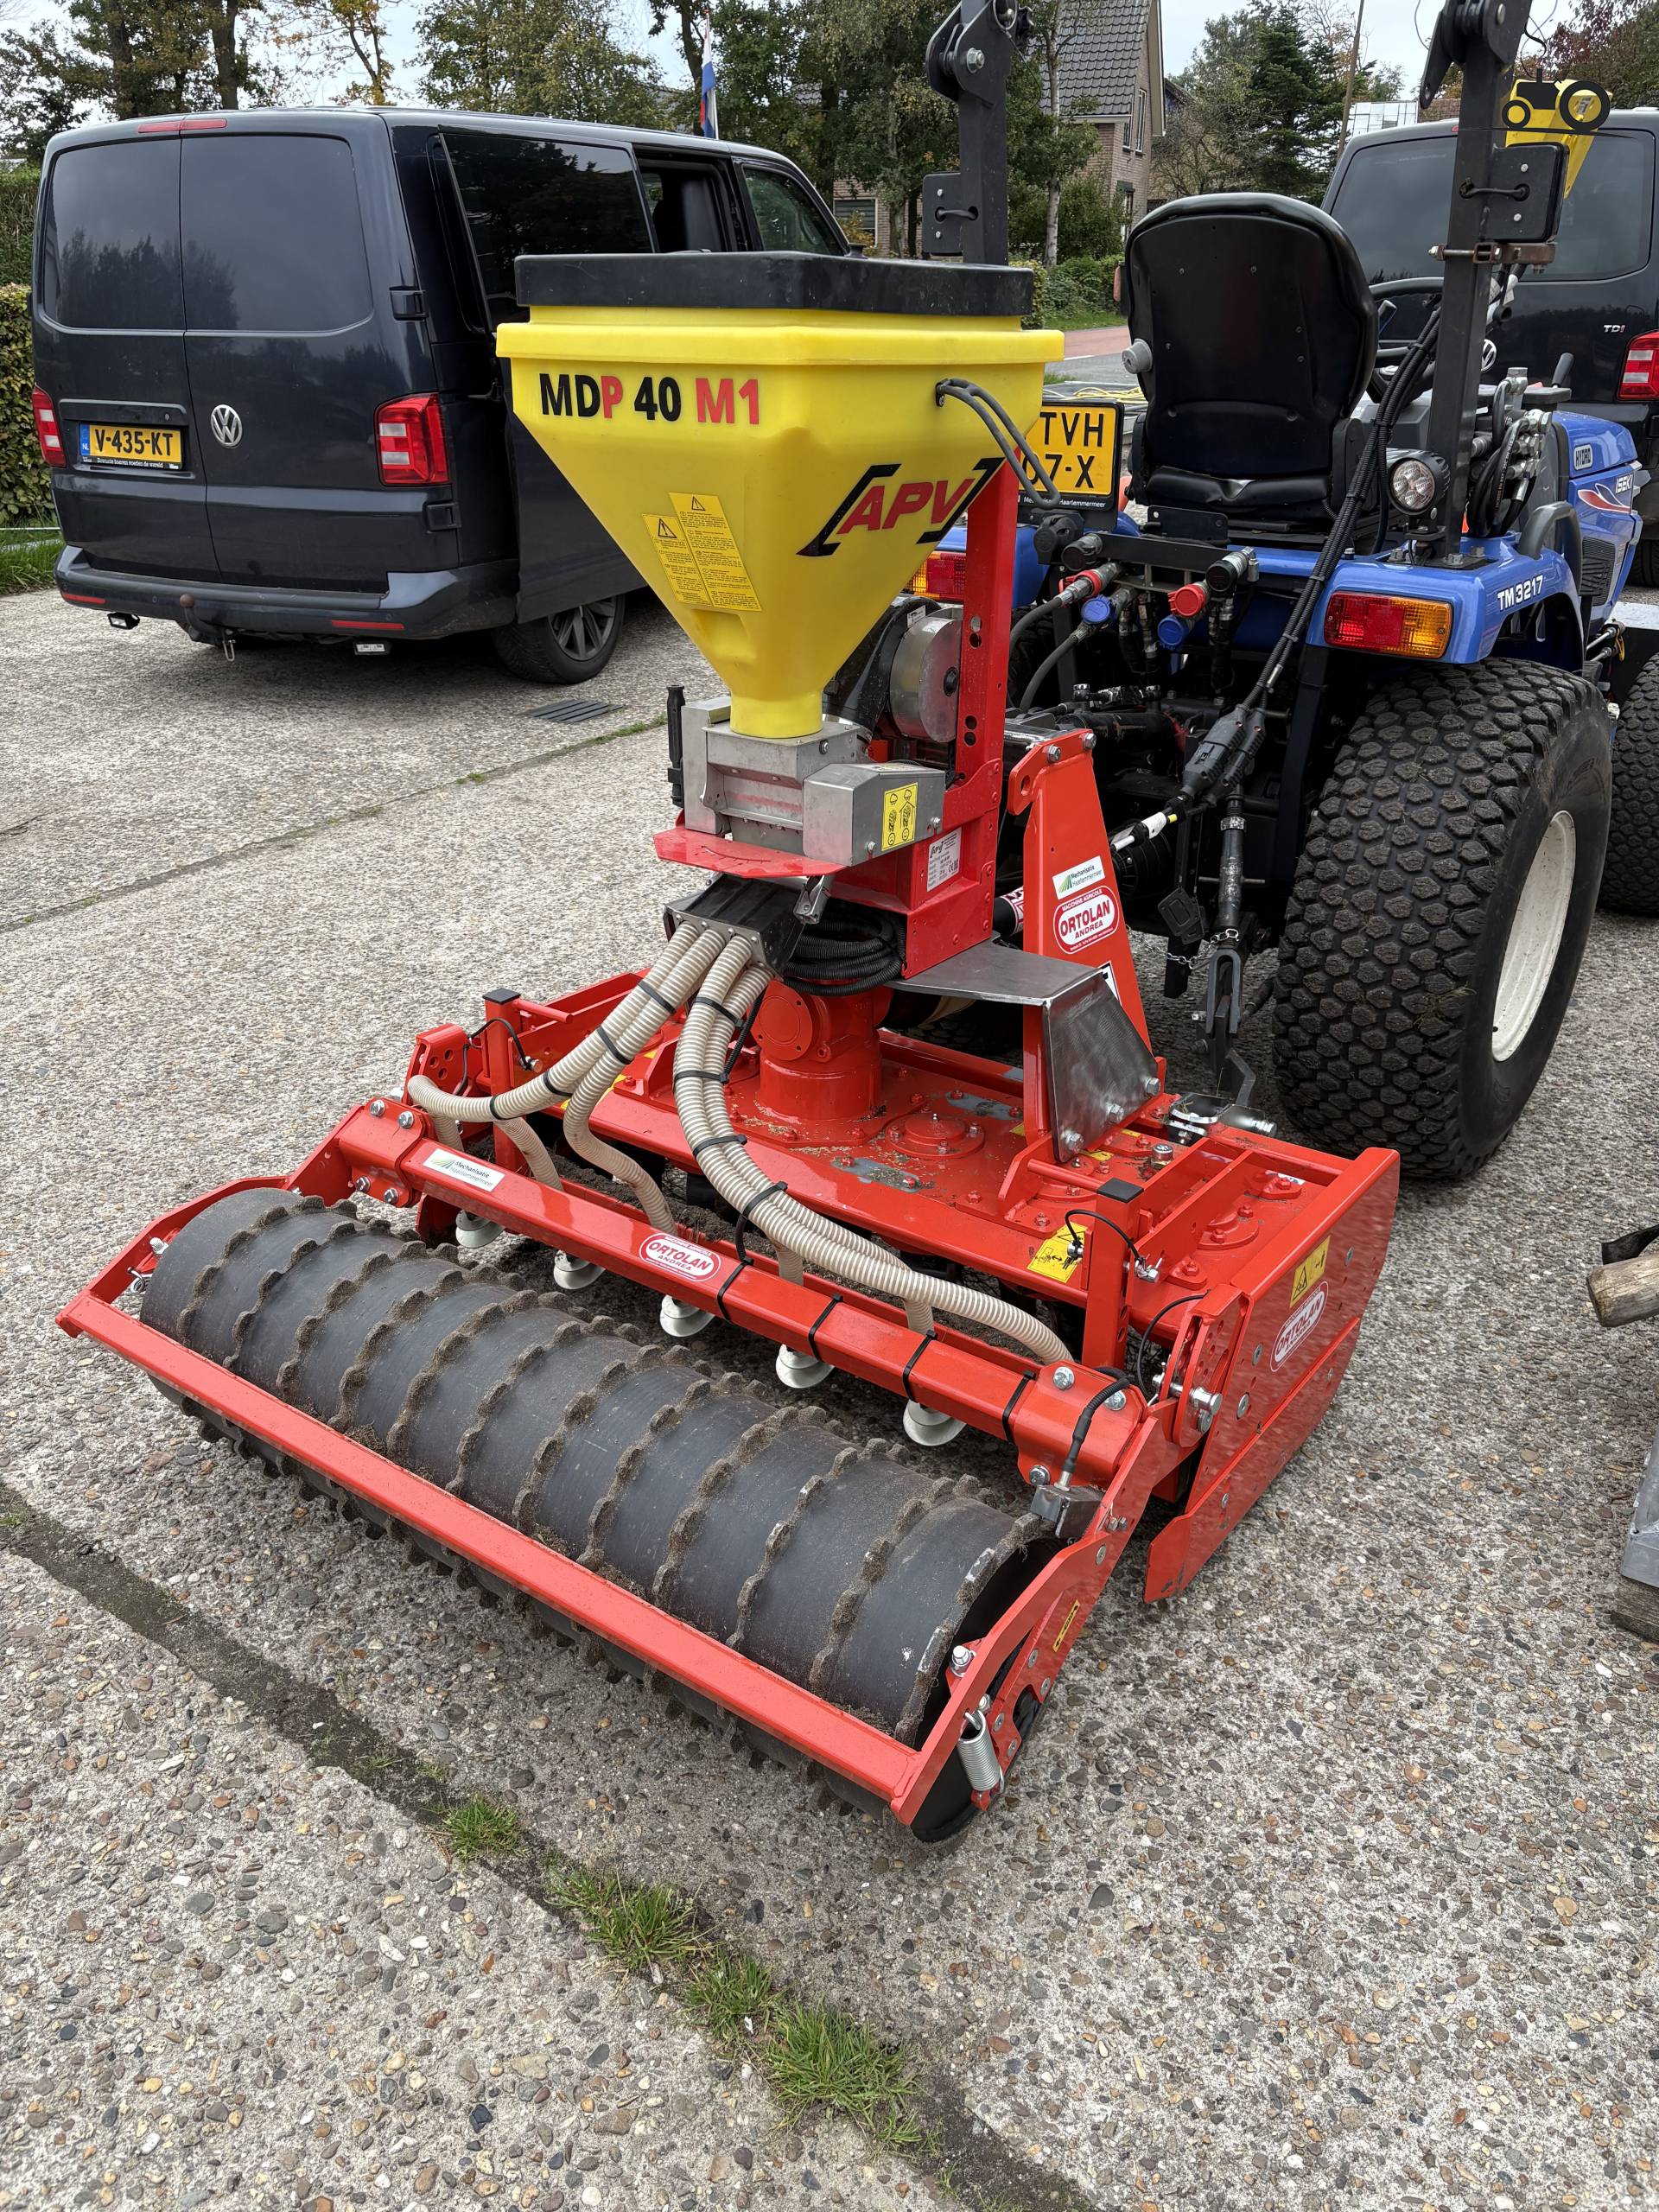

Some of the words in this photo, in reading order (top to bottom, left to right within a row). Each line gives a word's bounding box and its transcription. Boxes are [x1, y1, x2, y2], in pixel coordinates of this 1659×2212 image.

[1603, 324, 1625, 333] TDI
[539, 372, 623, 419] MDP
[634, 376, 682, 422] 40
[696, 378, 760, 425] M1
[95, 429, 173, 456] V-435-KT
[1039, 411, 1104, 448] TVH
[1497, 587, 1515, 611] TM
[1515, 574, 1543, 604] 3217
[1071, 864, 1095, 879] Mechanisatie
[1060, 899, 1110, 937] ORTOLAN
[1075, 919, 1103, 939] ANDREA
[455, 1160, 490, 1179] Mechanisatie
[649, 1242, 711, 1270] ORTOLAN
[658, 1255, 692, 1271] ANDREA
[1276, 1294, 1323, 1355] ORTOLAN
